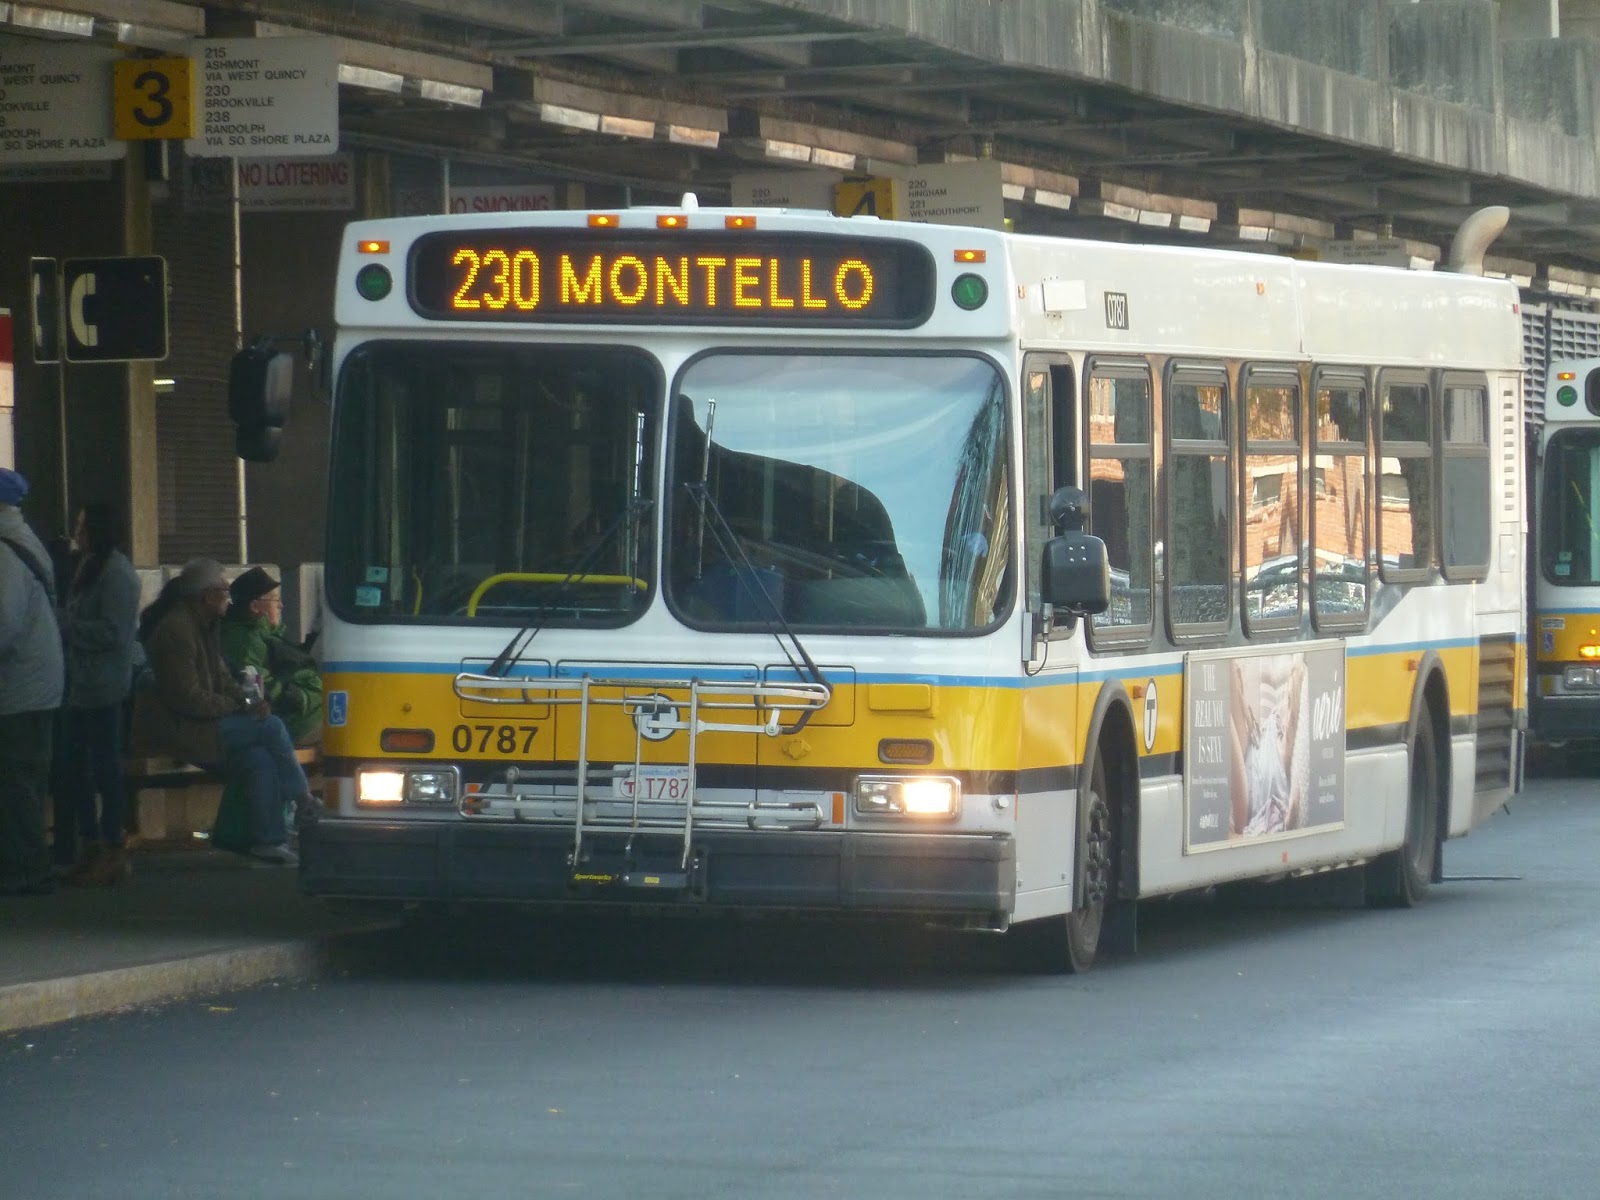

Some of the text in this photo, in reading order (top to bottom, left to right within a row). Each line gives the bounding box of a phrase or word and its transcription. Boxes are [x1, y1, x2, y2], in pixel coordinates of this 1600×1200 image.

[204, 47, 226, 58] 215
[205, 59, 260, 70] ASHMONT
[3, 73, 81, 86] WEST QUINCY
[205, 69, 307, 81] VIA WEST QUINCY
[205, 85, 231, 97] 230
[133, 71, 172, 126] 3
[205, 97, 275, 108] BROOKVILLE
[205, 124, 265, 134] RANDOLPH
[26, 139, 65, 150] SHORE
[69, 138, 106, 148] PLAZA
[205, 136, 223, 146] VIA
[250, 134, 289, 145] SHORE
[294, 134, 331, 144] PLAZA
[239, 162, 348, 186] NO LOITERING
[908, 180, 927, 190] 220
[908, 188, 947, 198] HINGHAM
[473, 194, 548, 212] SMOKING
[909, 200, 926, 209] 221
[453, 249, 873, 310] 230 MONTELLO
[1107, 293, 1125, 327] 0787
[1202, 664, 1217, 691] THE
[1194, 700, 1212, 728] REAL
[453, 724, 539, 756] 0787
[645, 777, 689, 799] T787
